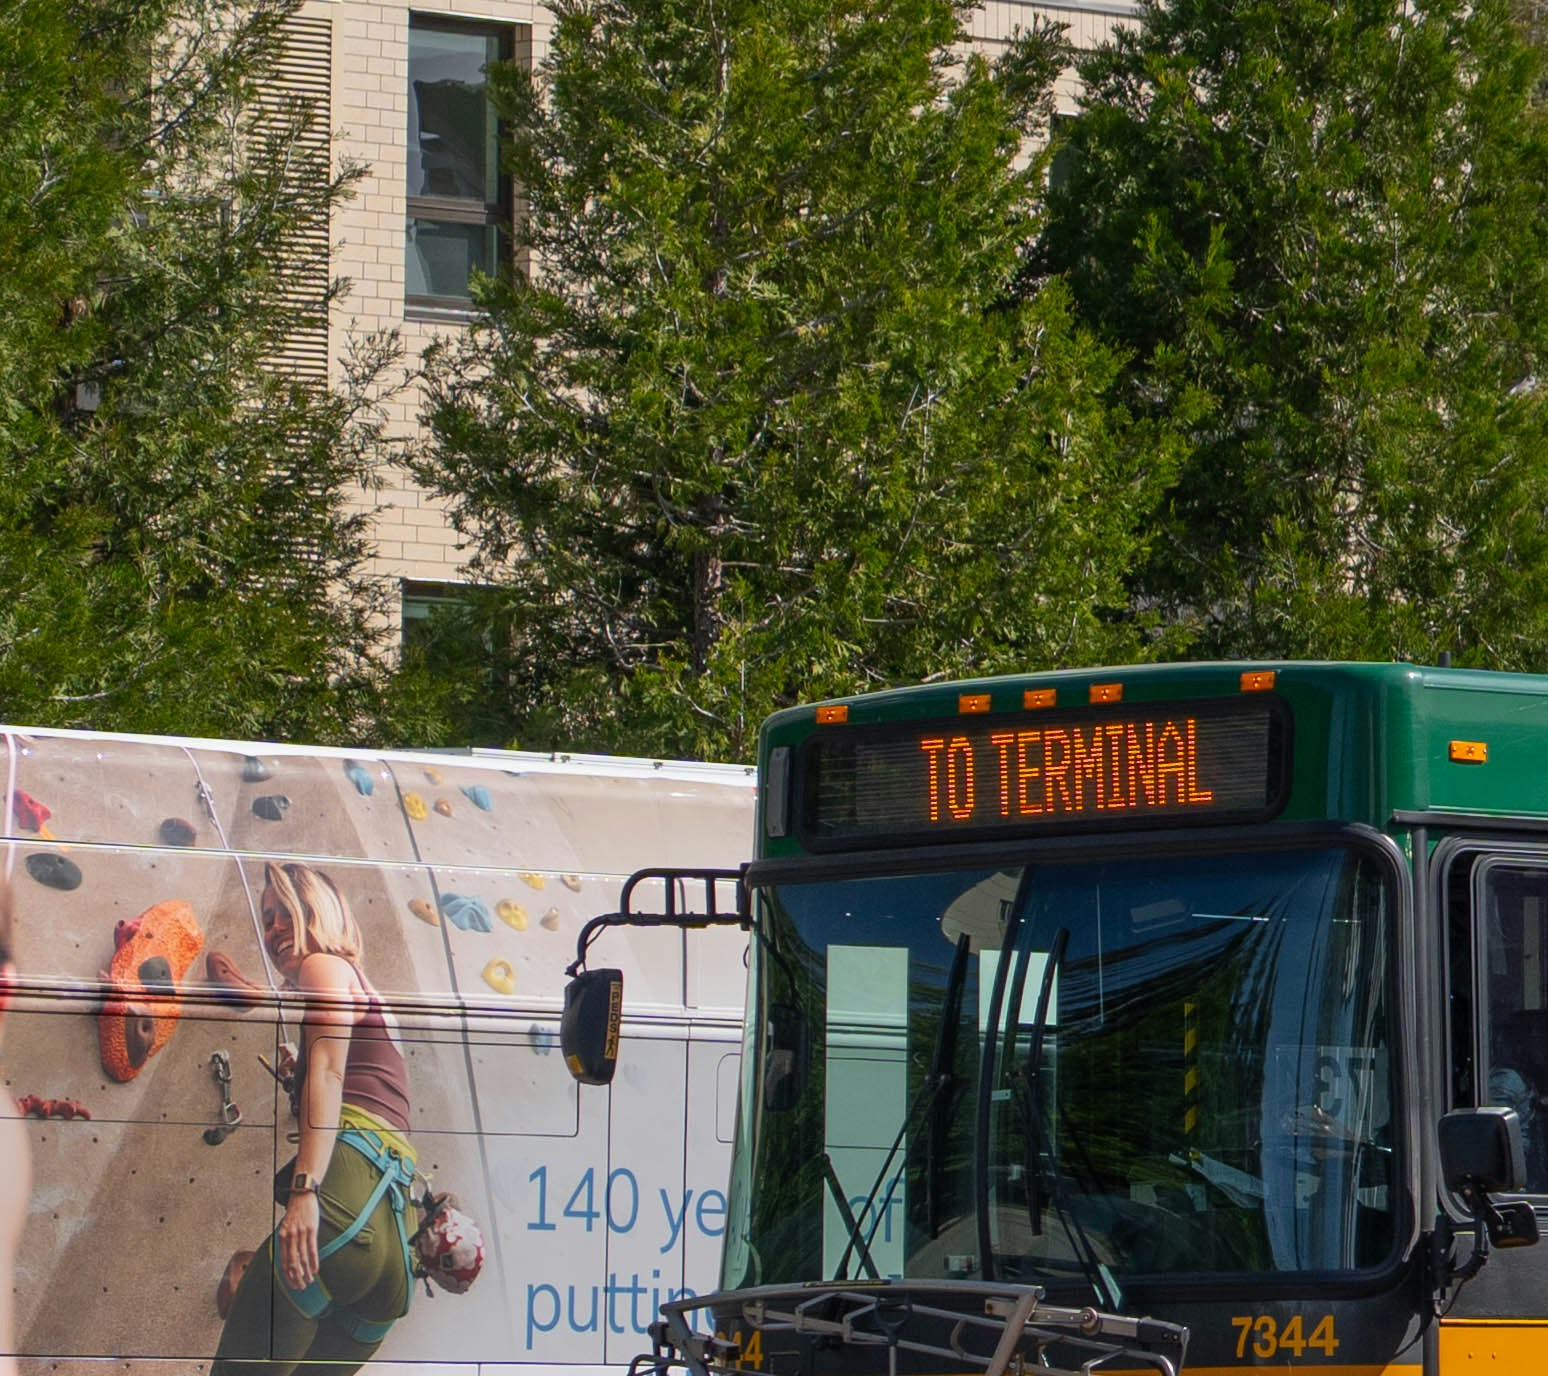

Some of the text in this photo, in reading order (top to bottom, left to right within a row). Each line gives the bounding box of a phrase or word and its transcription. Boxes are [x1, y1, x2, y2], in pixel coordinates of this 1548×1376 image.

[920, 718, 1214, 822] TO TERMINAL
[525, 1166, 640, 1233] 140
[526, 1269, 717, 1351] puttin
[1231, 1315, 1340, 1358] 7344
